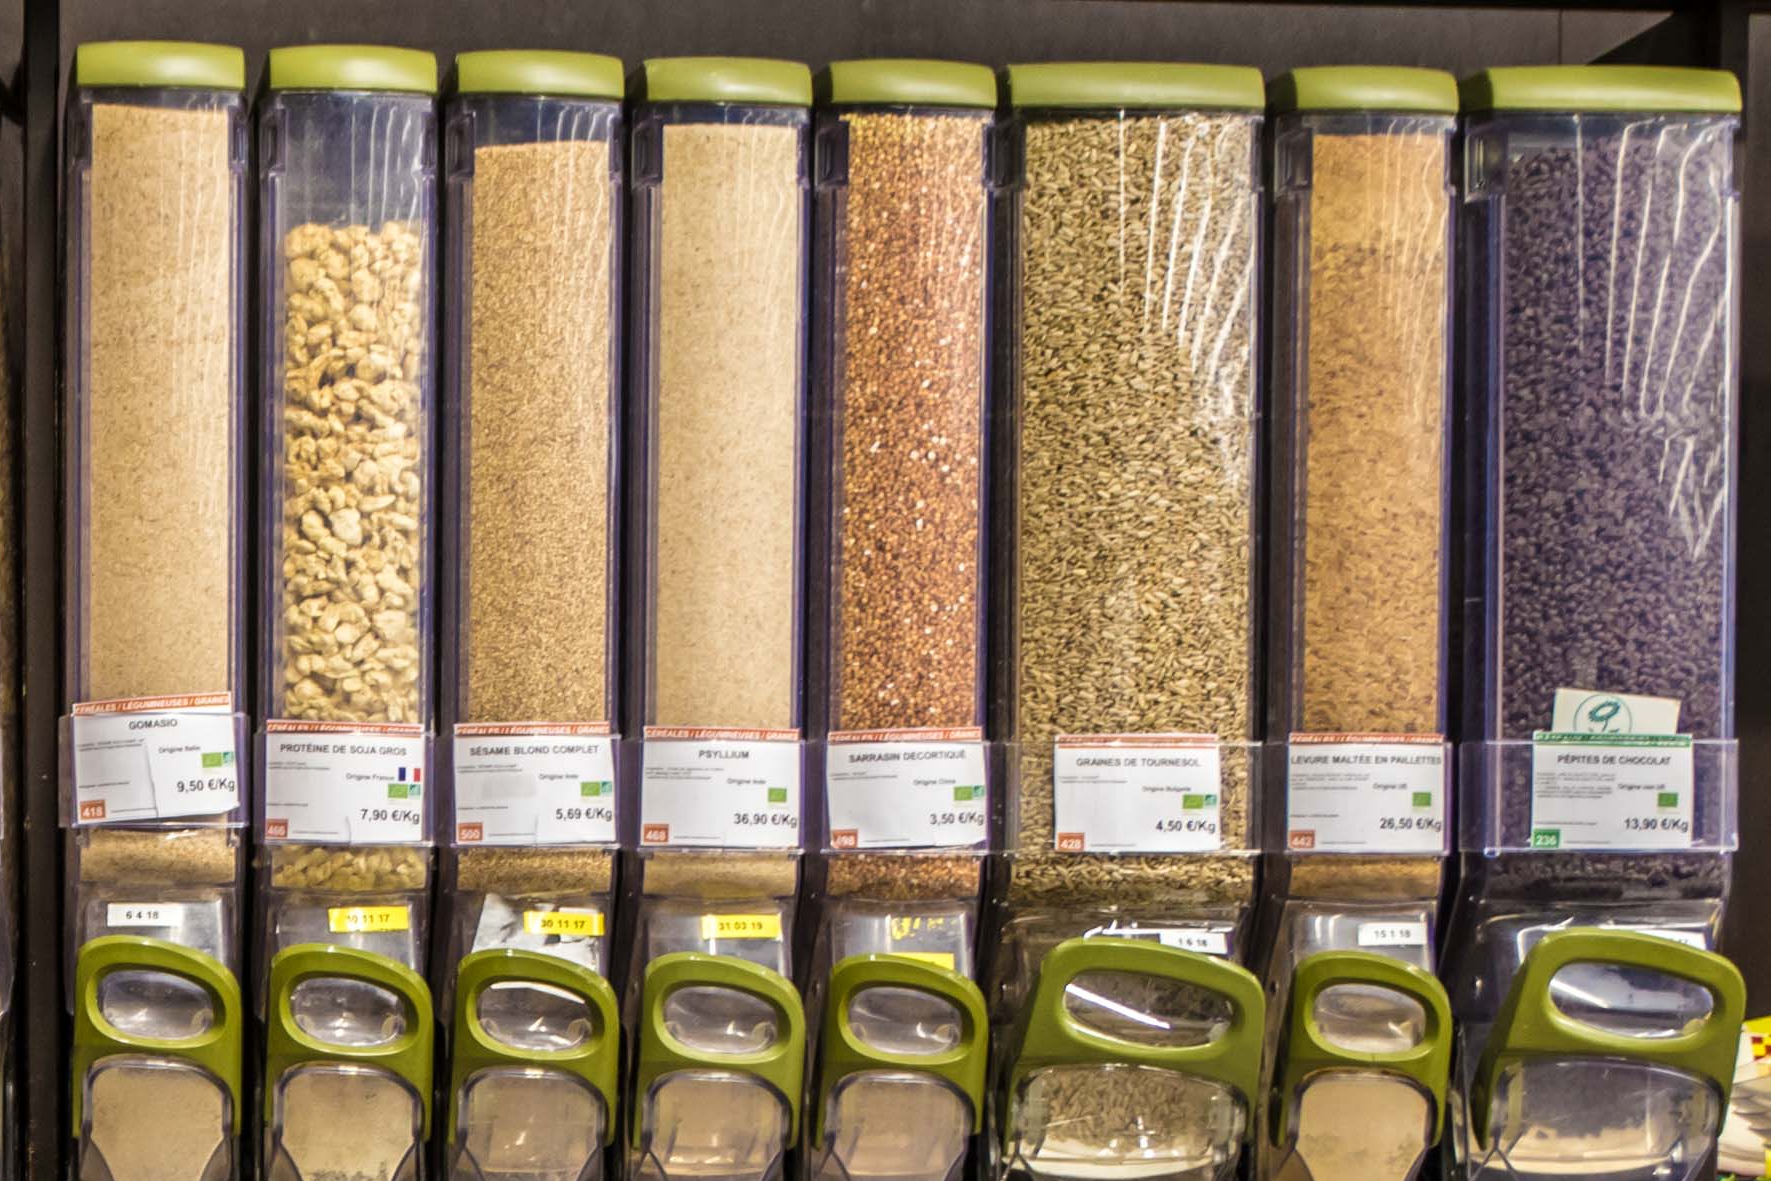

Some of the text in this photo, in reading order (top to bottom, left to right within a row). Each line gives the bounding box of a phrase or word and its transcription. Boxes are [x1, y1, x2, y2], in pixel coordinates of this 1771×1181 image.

[128, 719, 179, 730] GOMASIO
[332, 744, 347, 755] DE
[349, 745, 377, 755] SOJA
[378, 746, 407, 757] GROS
[513, 745, 550, 756] BLOND
[552, 744, 599, 754] COMPLET
[698, 749, 750, 759] PSYLLIUM
[848, 752, 901, 764] SARRASIN
[1075, 757, 1201, 767] GRAINES DE TOURNESOL
[1290, 755, 1330, 765] LEVURE
[1374, 755, 1389, 765] EN
[1389, 755, 1442, 765] PAILLETTES
[1601, 755, 1617, 766] DE
[1618, 755, 1672, 766] CHOCOLAT
[176, 778, 235, 794] 9,50 €/Kg
[360, 808, 420, 824] 7,90 €/Kg
[555, 807, 612, 822] 5,69 €/Kg
[733, 812, 798, 828] 36,90 €/Kg
[929, 812, 984, 826] 3,50 €/Kg
[1155, 819, 1216, 834] 4,50 €/Kg
[1379, 817, 1442, 831] 26,50 €/Kg
[1624, 817, 1689, 832] 13,90 €/Kg
